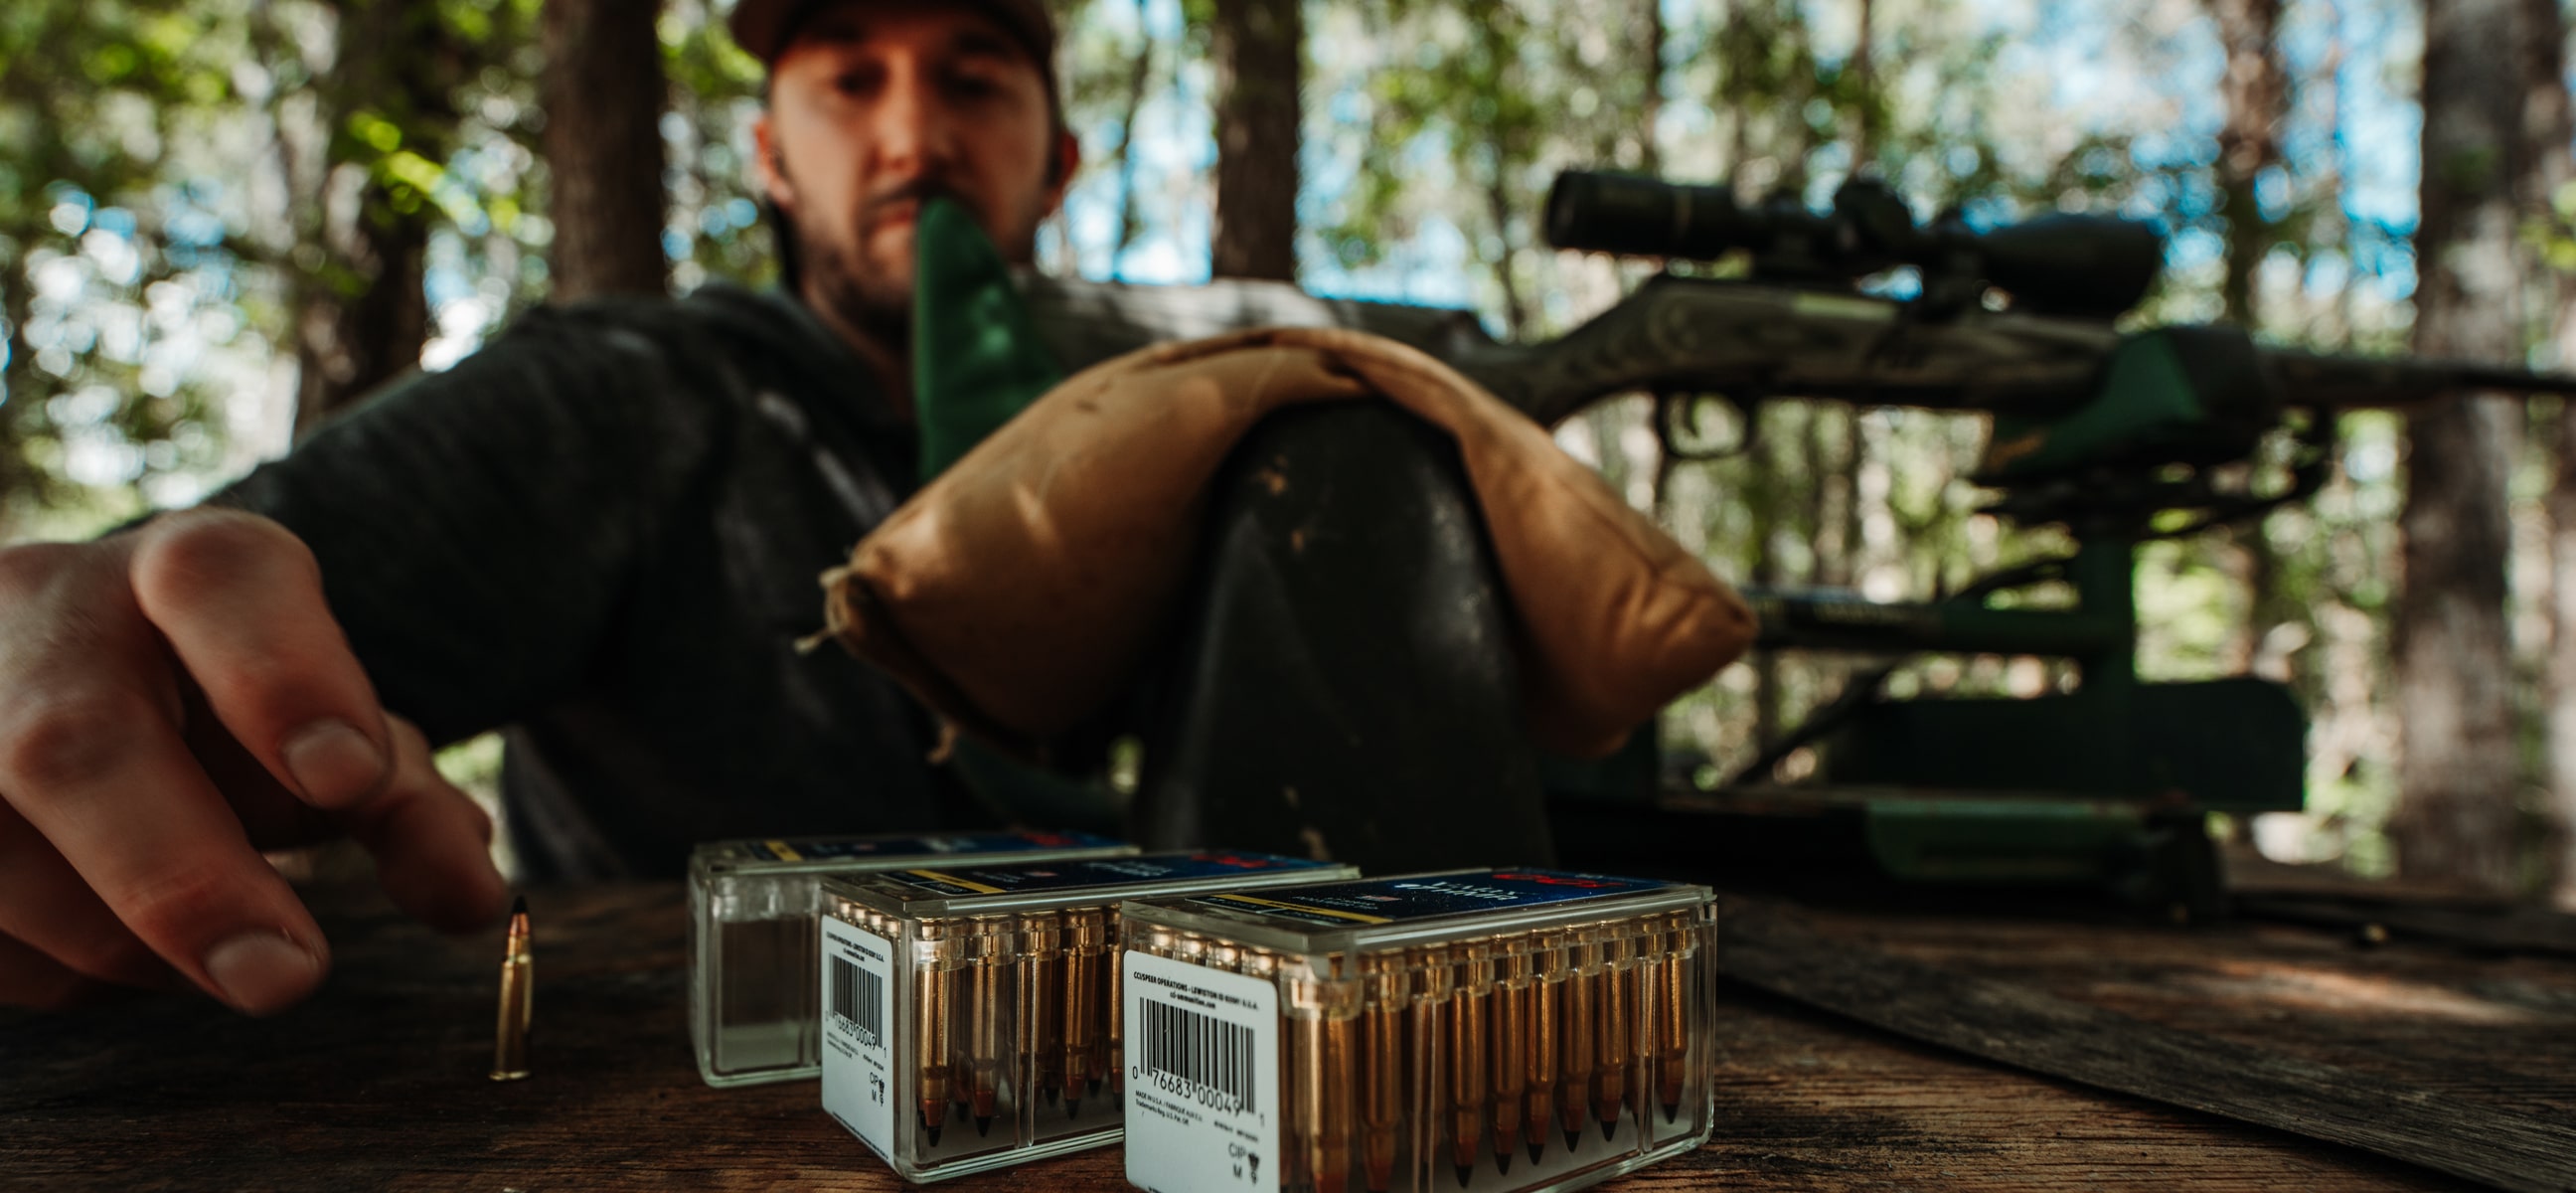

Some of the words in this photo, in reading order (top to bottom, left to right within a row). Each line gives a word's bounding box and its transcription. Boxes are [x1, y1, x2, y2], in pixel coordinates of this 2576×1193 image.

[1133, 970, 1157, 984] CCI/SPEER
[1157, 975, 1188, 992] OPERATIONS
[1132, 1066, 1138, 1080] 0
[1152, 1069, 1192, 1100] 76683
[1198, 1086, 1242, 1117] 00049
[1228, 1143, 1246, 1159] CIP
[1233, 1164, 1242, 1179] M
